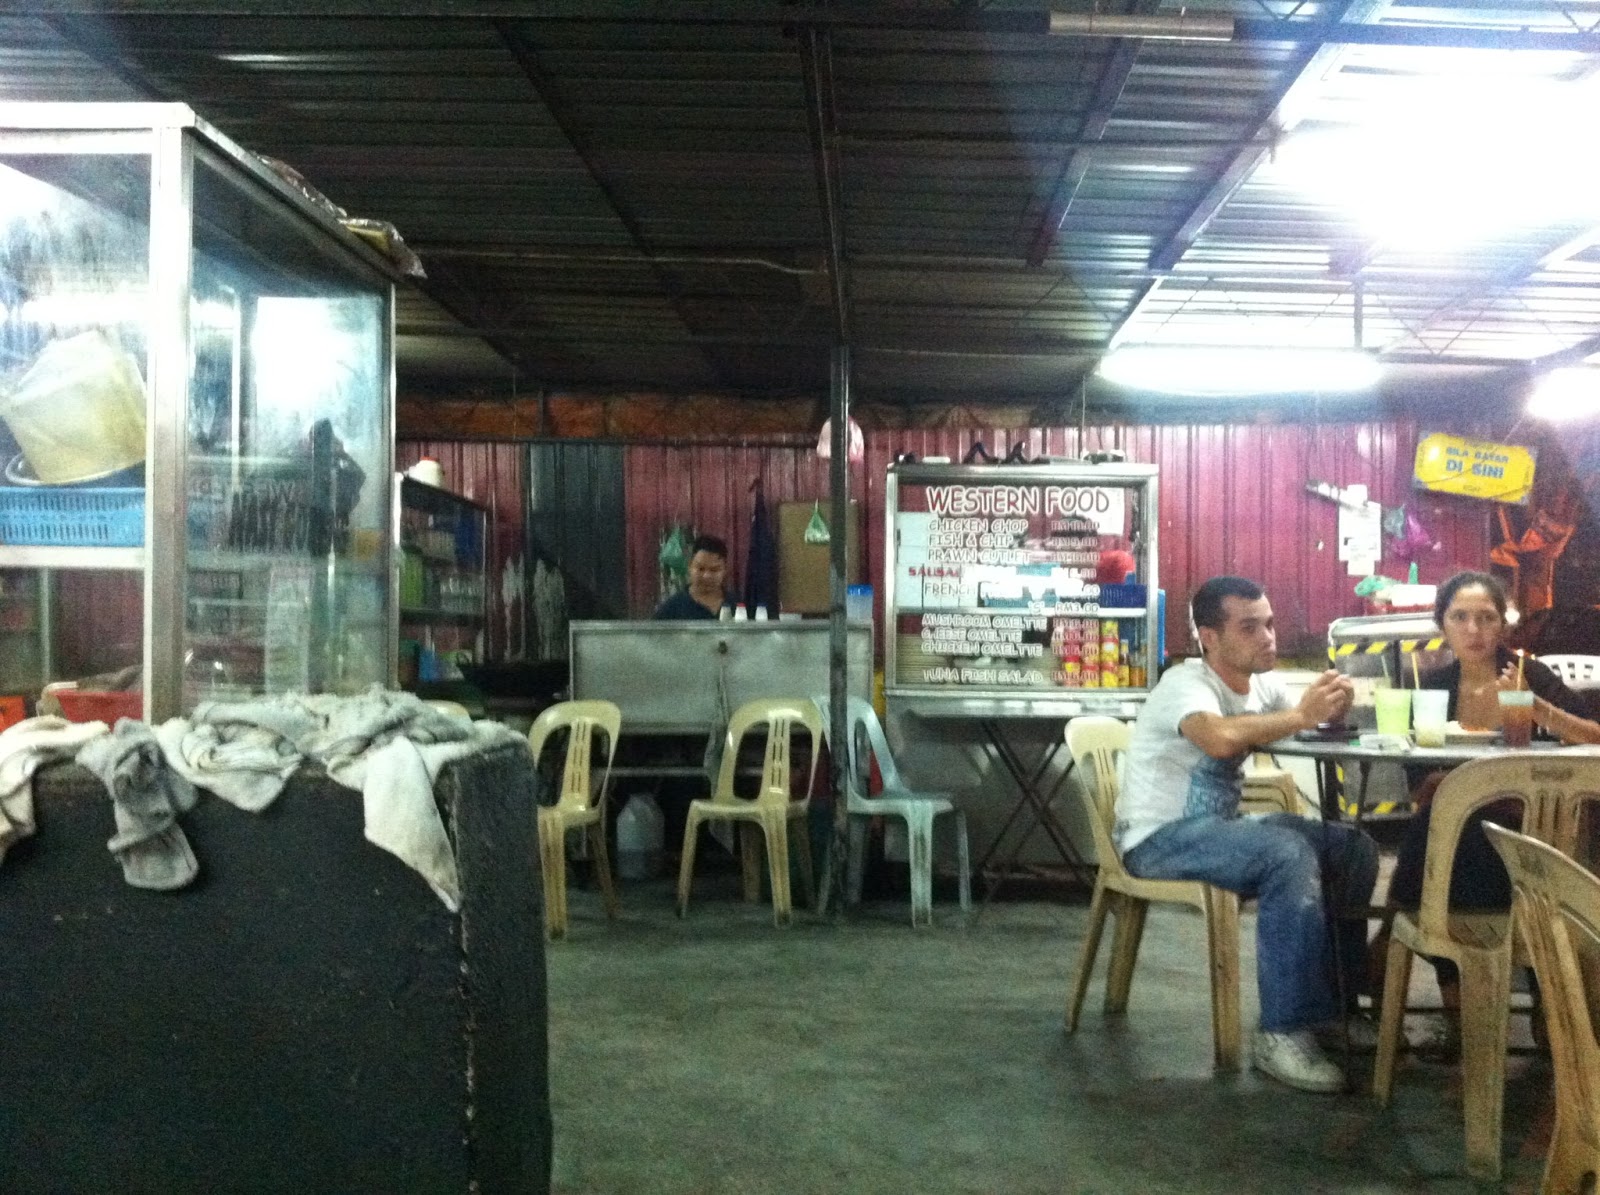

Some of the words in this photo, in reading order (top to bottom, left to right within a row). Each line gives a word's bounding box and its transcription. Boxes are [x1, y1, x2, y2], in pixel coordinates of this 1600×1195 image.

[1446, 459, 1463, 472] DI
[1471, 463, 1504, 479] SINI
[926, 486, 1039, 514] WESTERN
[1044, 486, 1110, 514] FOOD
[928, 518, 988, 533] CHICKEN
[991, 518, 1029, 533] CHOP
[928, 533, 963, 547] FISH
[966, 533, 977, 547] &
[980, 533, 1014, 548] CHIP
[928, 549, 977, 563] PRAWN
[980, 549, 1031, 564] CUTLET
[922, 614, 992, 628] MUSHROOM
[921, 628, 966, 641] CHEESE
[921, 641, 980, 655] CHICKEN
[923, 668, 959, 682] TUNA
[961, 668, 996, 682] FISH
[998, 669, 1043, 683] SALAD
